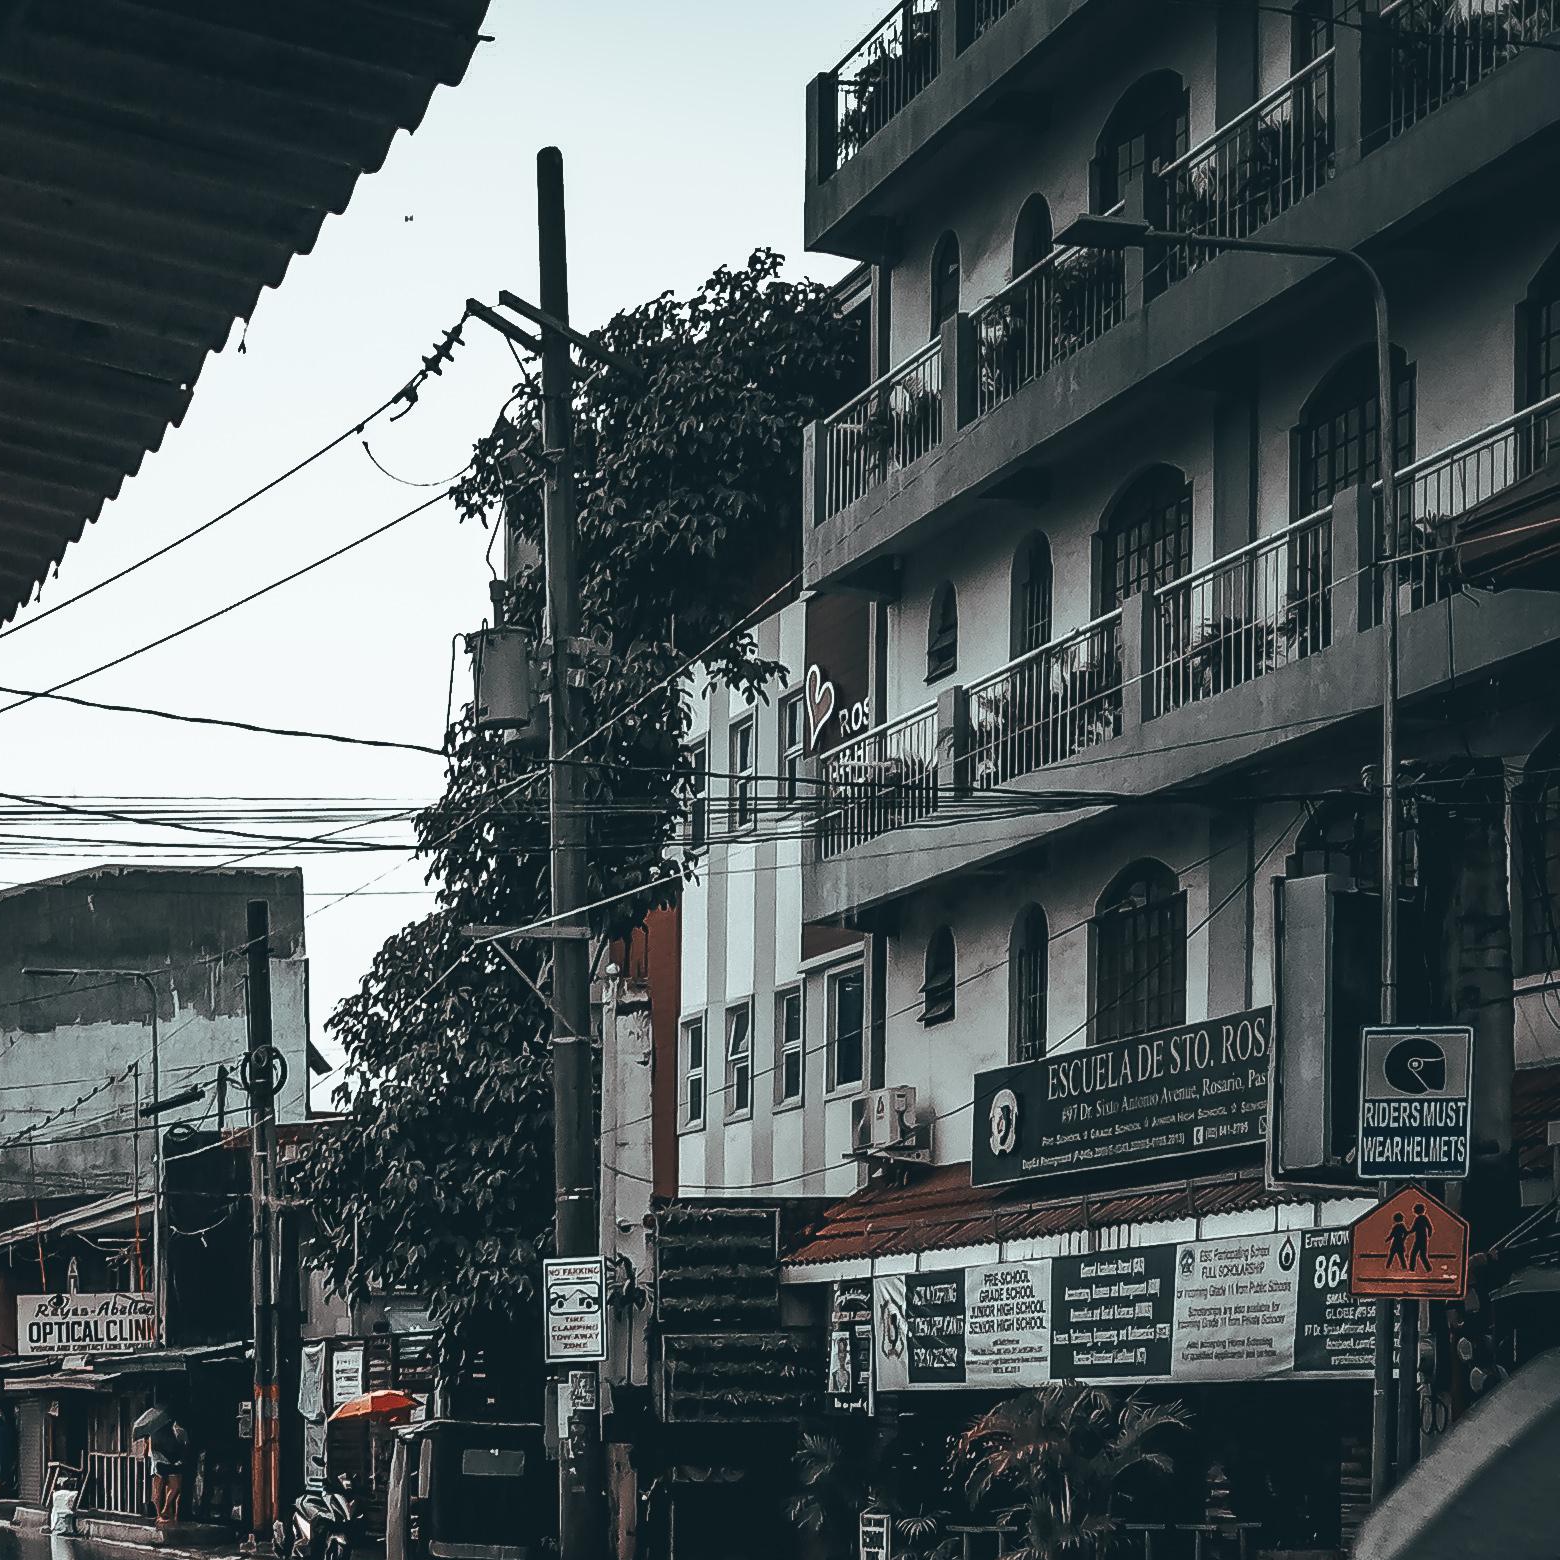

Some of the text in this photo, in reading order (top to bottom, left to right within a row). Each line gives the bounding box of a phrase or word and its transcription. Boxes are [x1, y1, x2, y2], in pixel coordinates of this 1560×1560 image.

[1048, 1017, 1272, 1100] ESCUELA DE STO. ROS
[1202, 1072, 1244, 1096] Rosario,
[1364, 1101, 1466, 1128] RIDERS MUST
[1363, 1136, 1465, 1163] WEAR HELMETS
[1305, 1232, 1329, 1248] Enroll
[549, 1266, 600, 1277] NO PARKING
[984, 1269, 1030, 1287] PRE-SCHOOL
[980, 1285, 1035, 1303] GRADE SCHOOL
[970, 1300, 1046, 1319] JUNIOR HIGH SCHOOL
[28, 1318, 156, 1344] OPTICAL CLINI
[552, 1324, 599, 1332] CLAMPING
[969, 1320, 995, 1335] SENIOR
[997, 1318, 1014, 1332] HIGH
[1016, 1316, 1047, 1331] SCHOOL
[563, 1342, 588, 1350] ZONE
